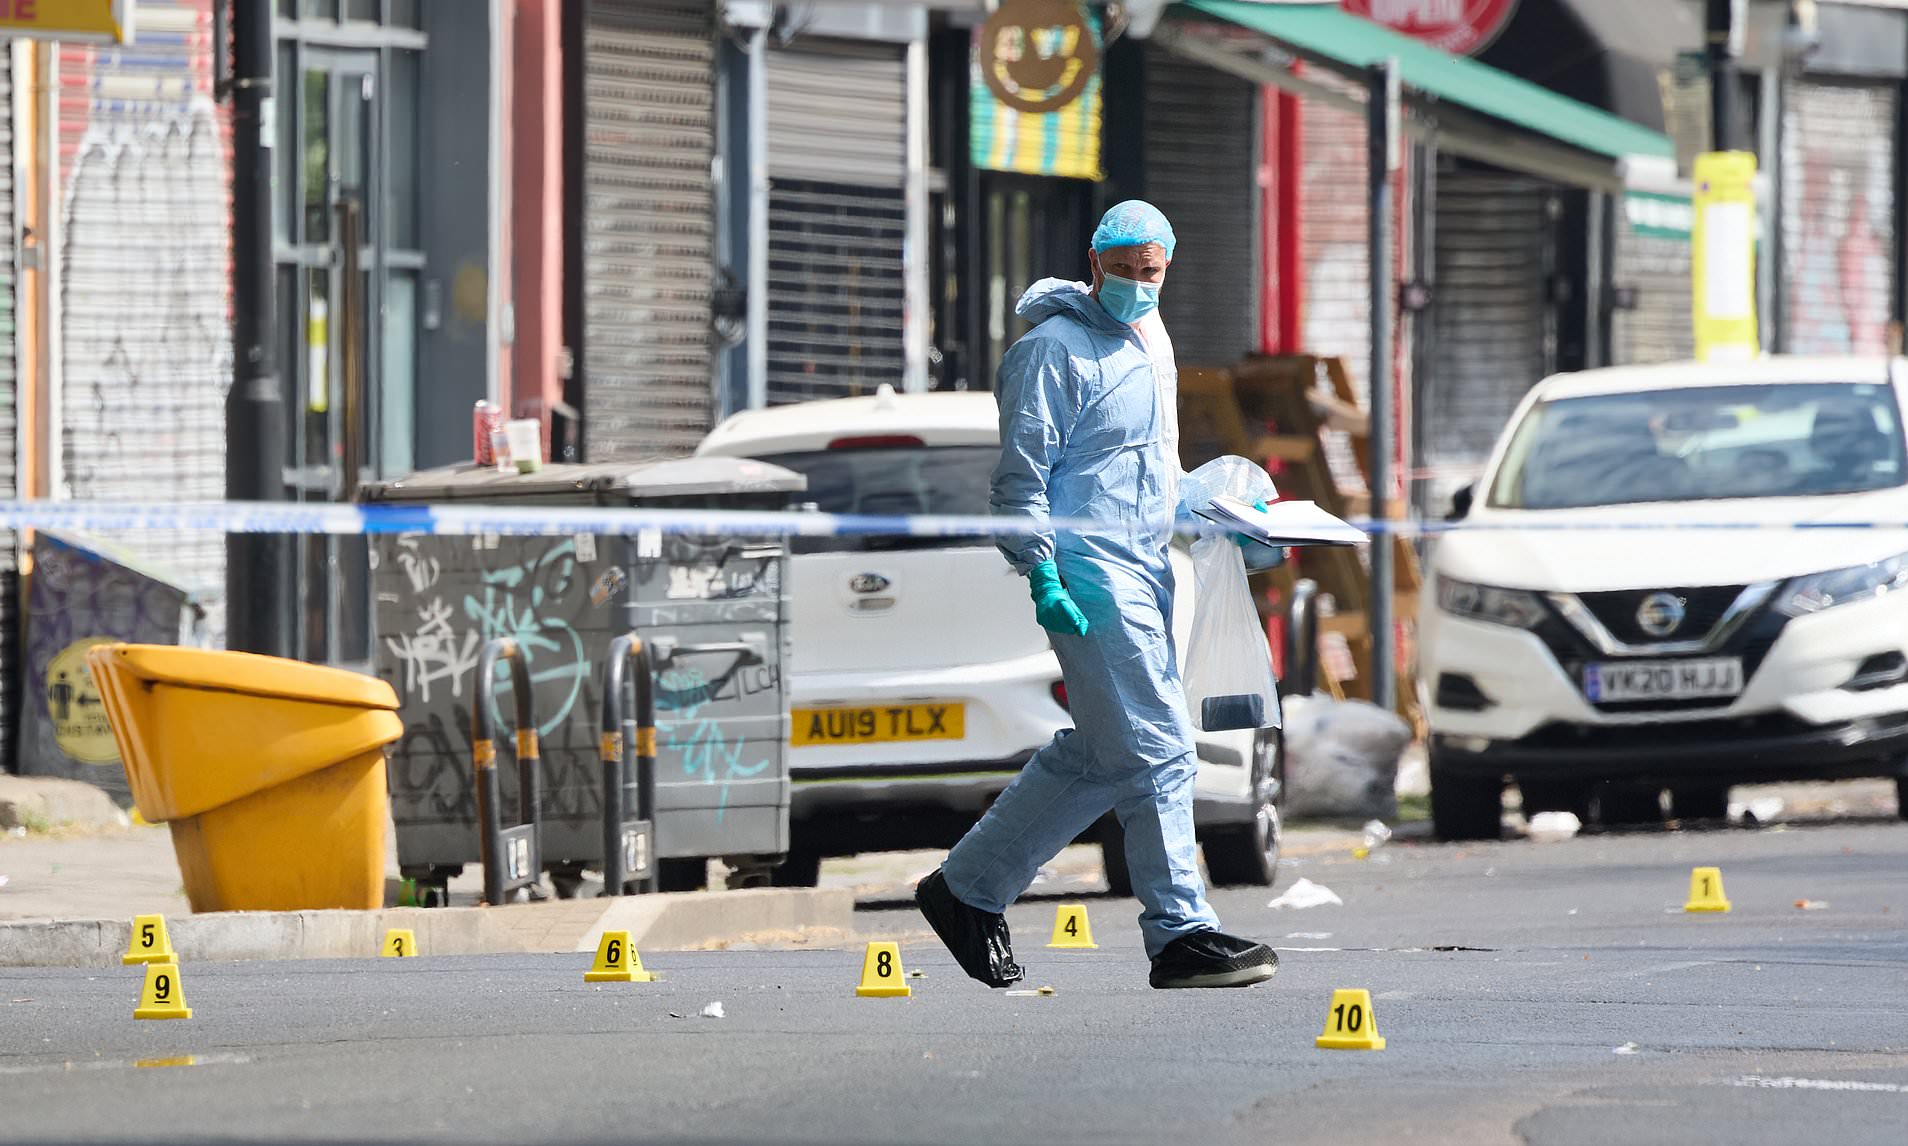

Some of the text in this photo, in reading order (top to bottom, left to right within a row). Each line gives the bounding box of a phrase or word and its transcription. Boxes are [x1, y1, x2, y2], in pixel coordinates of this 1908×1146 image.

[1680, 665, 1735, 689] HJJ
[808, 706, 946, 739] AU19 TLX
[1702, 876, 1709, 897] 1
[141, 924, 154, 948] 5
[1064, 915, 1078, 937] 4
[606, 939, 621, 964] 6
[877, 950, 892, 978] 8
[155, 974, 170, 1000] 9
[1333, 1003, 1362, 1033] 10
